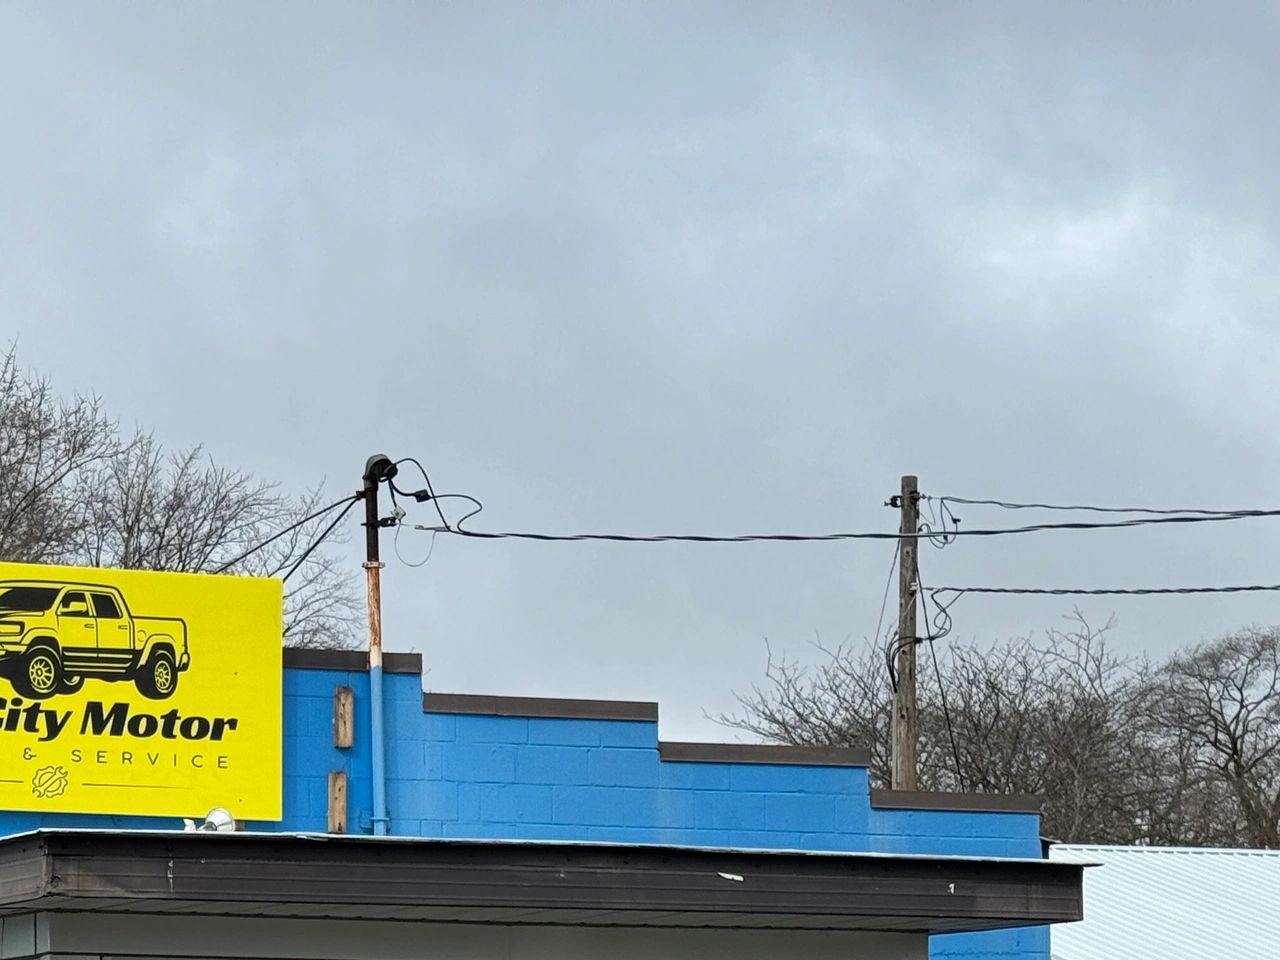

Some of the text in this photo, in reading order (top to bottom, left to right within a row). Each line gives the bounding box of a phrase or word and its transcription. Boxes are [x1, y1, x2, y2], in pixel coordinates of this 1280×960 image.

[82, 701, 238, 741] Motor
[23, 748, 37, 761] &
[71, 750, 230, 769] SERVICE
